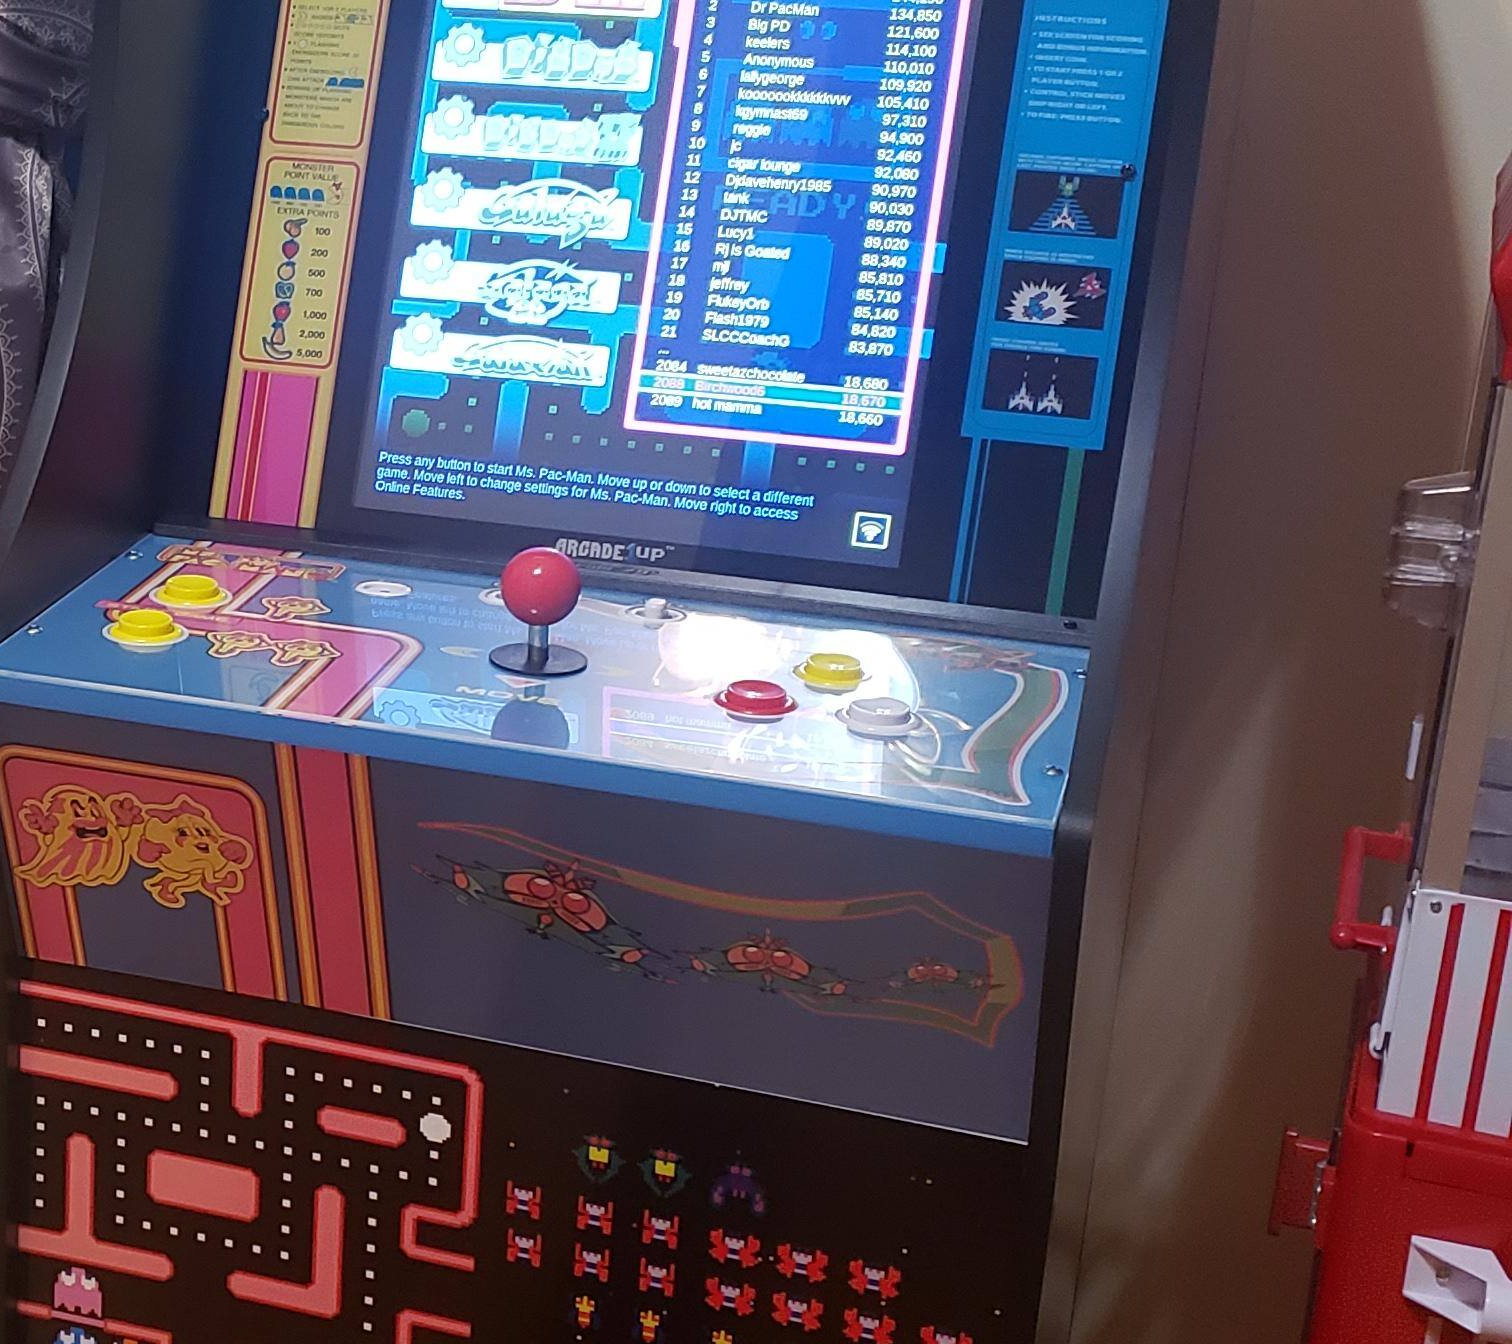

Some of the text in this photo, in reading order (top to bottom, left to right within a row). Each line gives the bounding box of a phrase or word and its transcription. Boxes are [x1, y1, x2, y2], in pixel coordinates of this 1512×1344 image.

[709, 0, 943, 22] 2 Dr PacMan 134,850
[706, 17, 939, 40] 3 Big PD 121,600
[703, 33, 713, 45] 4
[885, 43, 938, 58] 114,100
[701, 50, 935, 75] 5 Anonymous 110,010
[699, 68, 708, 80] 6
[879, 78, 932, 93] 109,920
[697, 85, 706, 98] 7
[876, 96, 930, 110] 105,410
[693, 102, 703, 114] 8
[882, 113, 927, 128] 97,310
[689, 137, 706, 149] 10
[691, 120, 701, 131] 9
[879, 131, 925, 145] 94,900
[283, 170, 338, 182] POINT VALUE
[292, 162, 334, 172] MONSTER
[686, 154, 701, 166] 11
[760, 159, 801, 175] lounge
[684, 171, 701, 184] 12
[871, 183, 917, 199] 90,970
[277, 206, 340, 220] EXTRA POINTS
[681, 189, 698, 201] 13
[869, 201, 914, 216] 90,030
[679, 205, 696, 218] 14
[866, 219, 912, 234] 89,870
[315, 227, 331, 236] 100
[676, 222, 693, 235] 15
[863, 236, 910, 251] 89,020
[310, 248, 328, 258] 200
[673, 239, 691, 253] 16
[861, 253, 907, 269] 88,340
[307, 268, 326, 278] 500
[670, 257, 689, 270] 17
[858, 271, 904, 286] 85,810
[305, 288, 323, 297] 700
[668, 274, 686, 287] 18
[856, 288, 901, 304] 85,710
[303, 310, 328, 321] 1,000
[662, 308, 681, 321] 20
[665, 291, 683, 304] 19
[853, 306, 899, 321] 85,140
[299, 329, 326, 340] 2,000
[660, 325, 677, 338] 21
[848, 340, 894, 356] 83,870
[296, 349, 323, 359] 5,000
[692, 397, 712, 410] hot
[375, 480, 466, 500] Online Features.
[378, 452, 815, 507] Press any button to start Ms. Pac-Man. Move up or down to select a different
[376, 467, 799, 521] game. Move left to change settings for Ms. Pac-Man. Move right to access
[456, 684, 561, 707] MOVE
